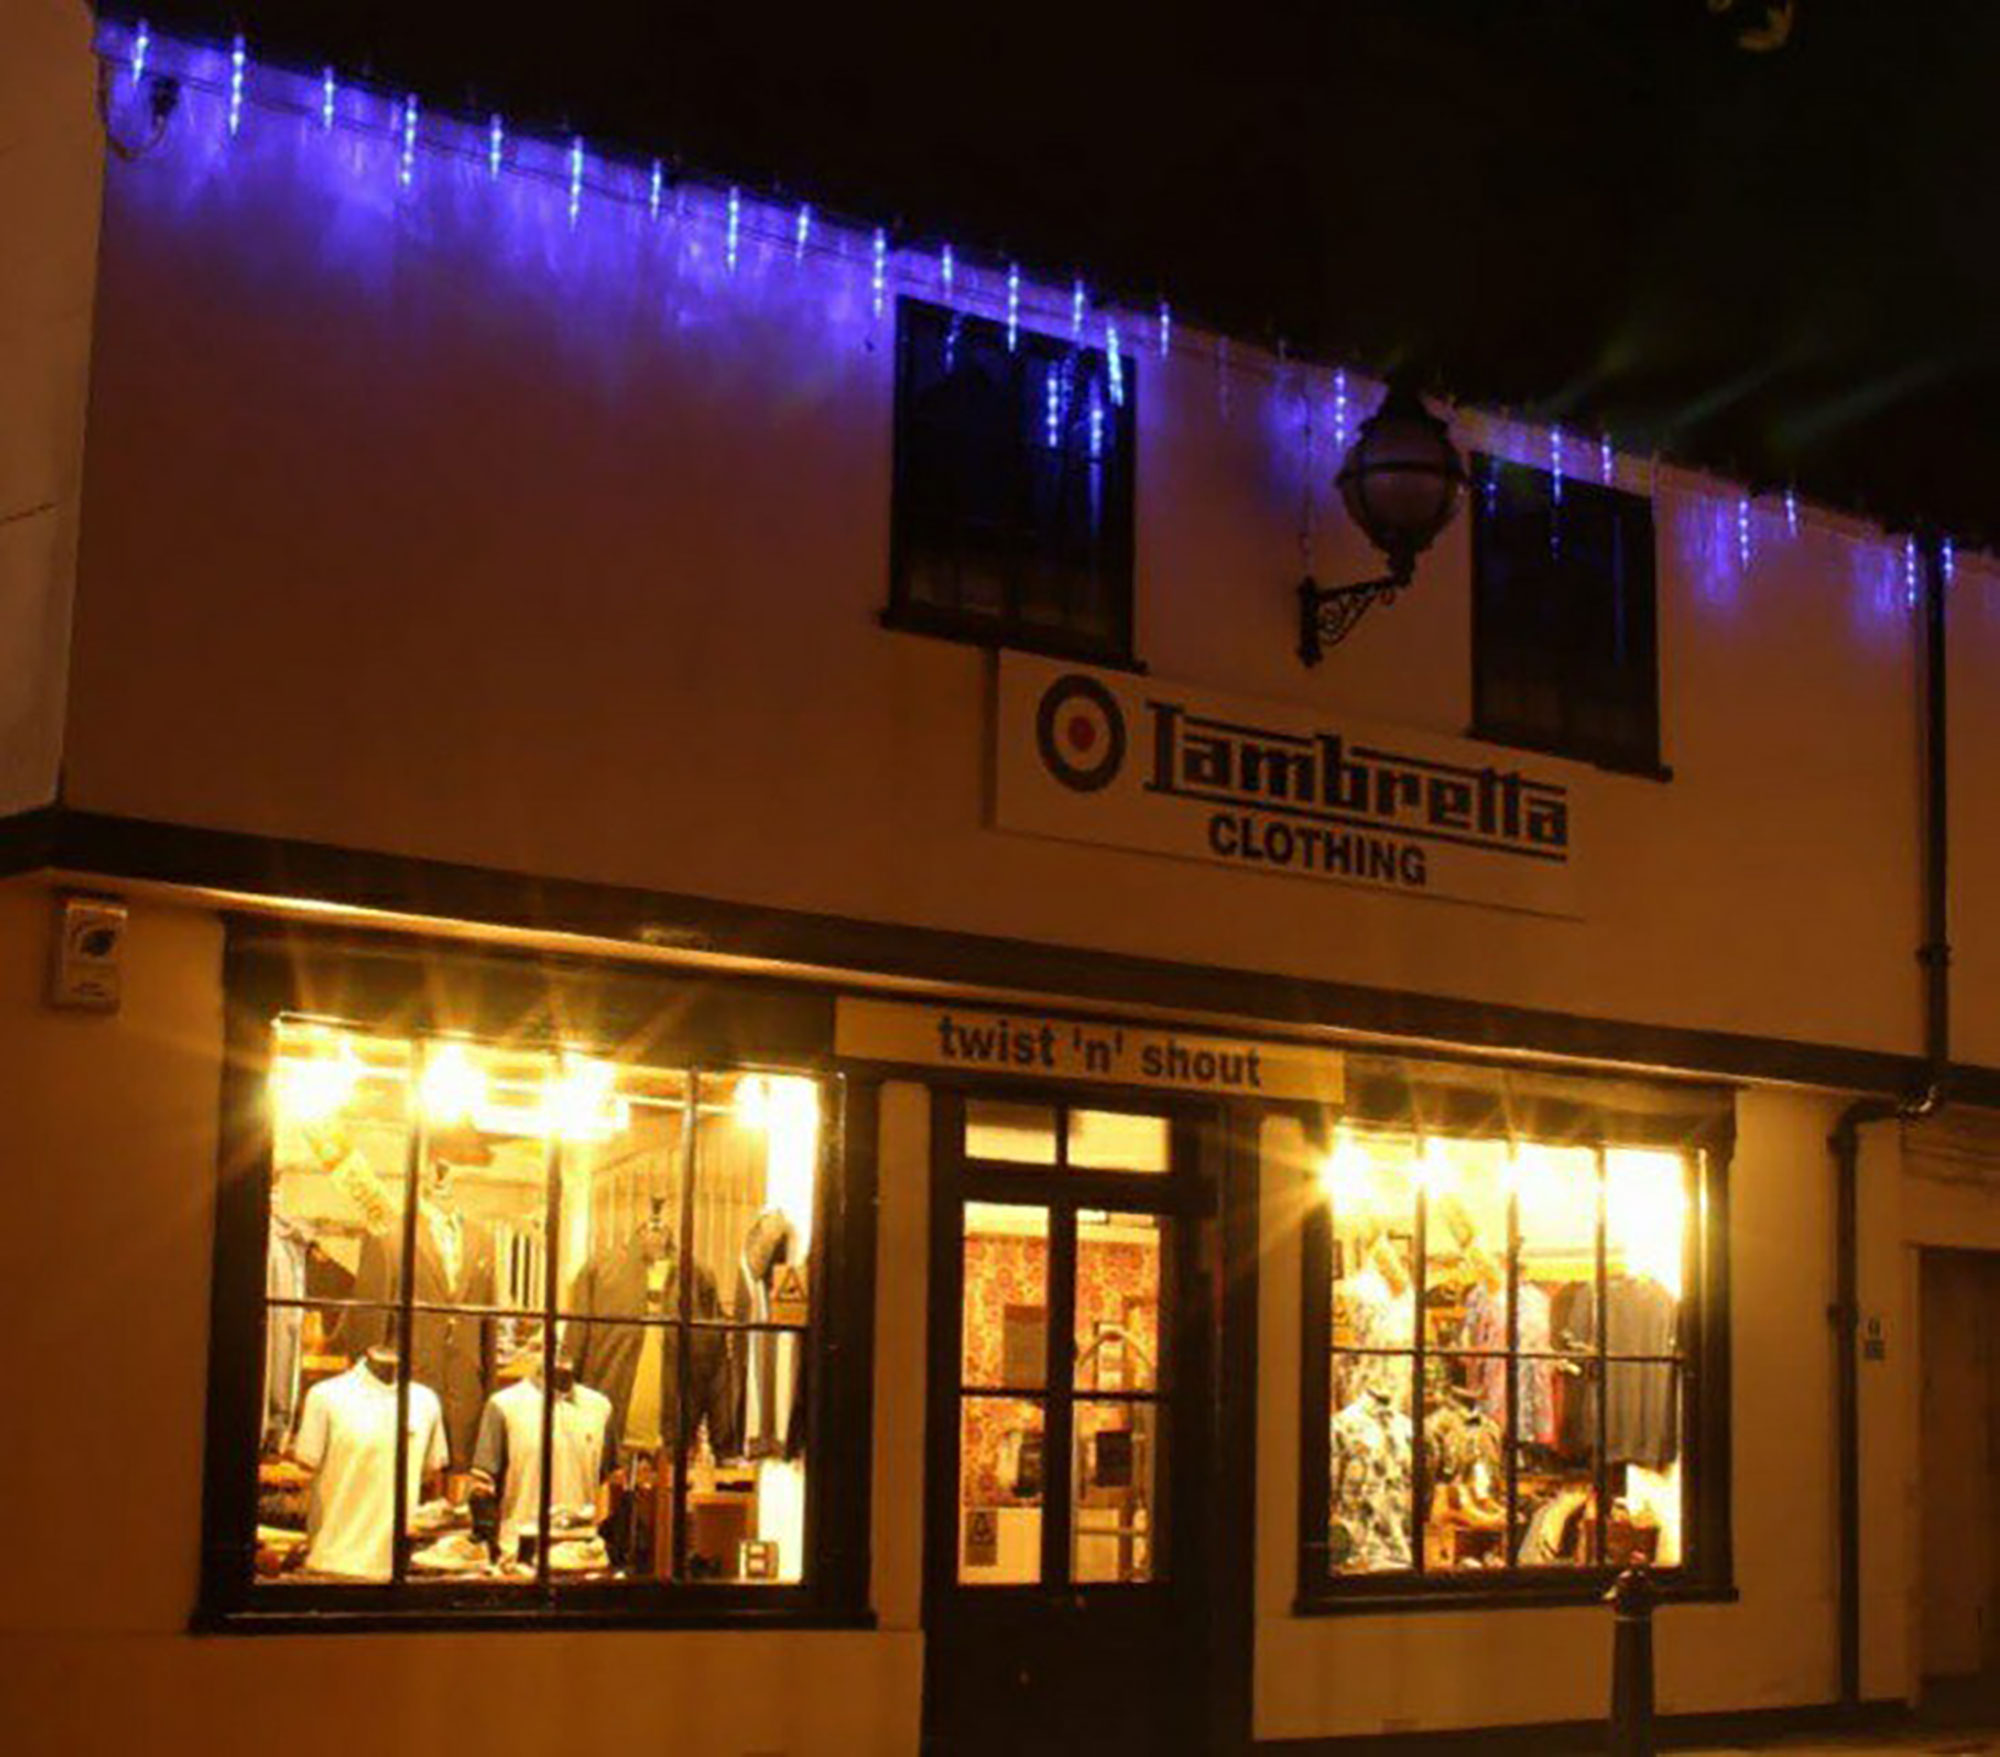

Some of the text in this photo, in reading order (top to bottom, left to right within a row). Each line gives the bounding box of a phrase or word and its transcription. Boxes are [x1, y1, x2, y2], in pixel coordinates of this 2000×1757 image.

[1145, 701, 1567, 860] Lambretta
[1209, 813, 1427, 885] CLOTHING
[939, 1015, 1055, 1067] twist
[1141, 1038, 1262, 1088] shout
